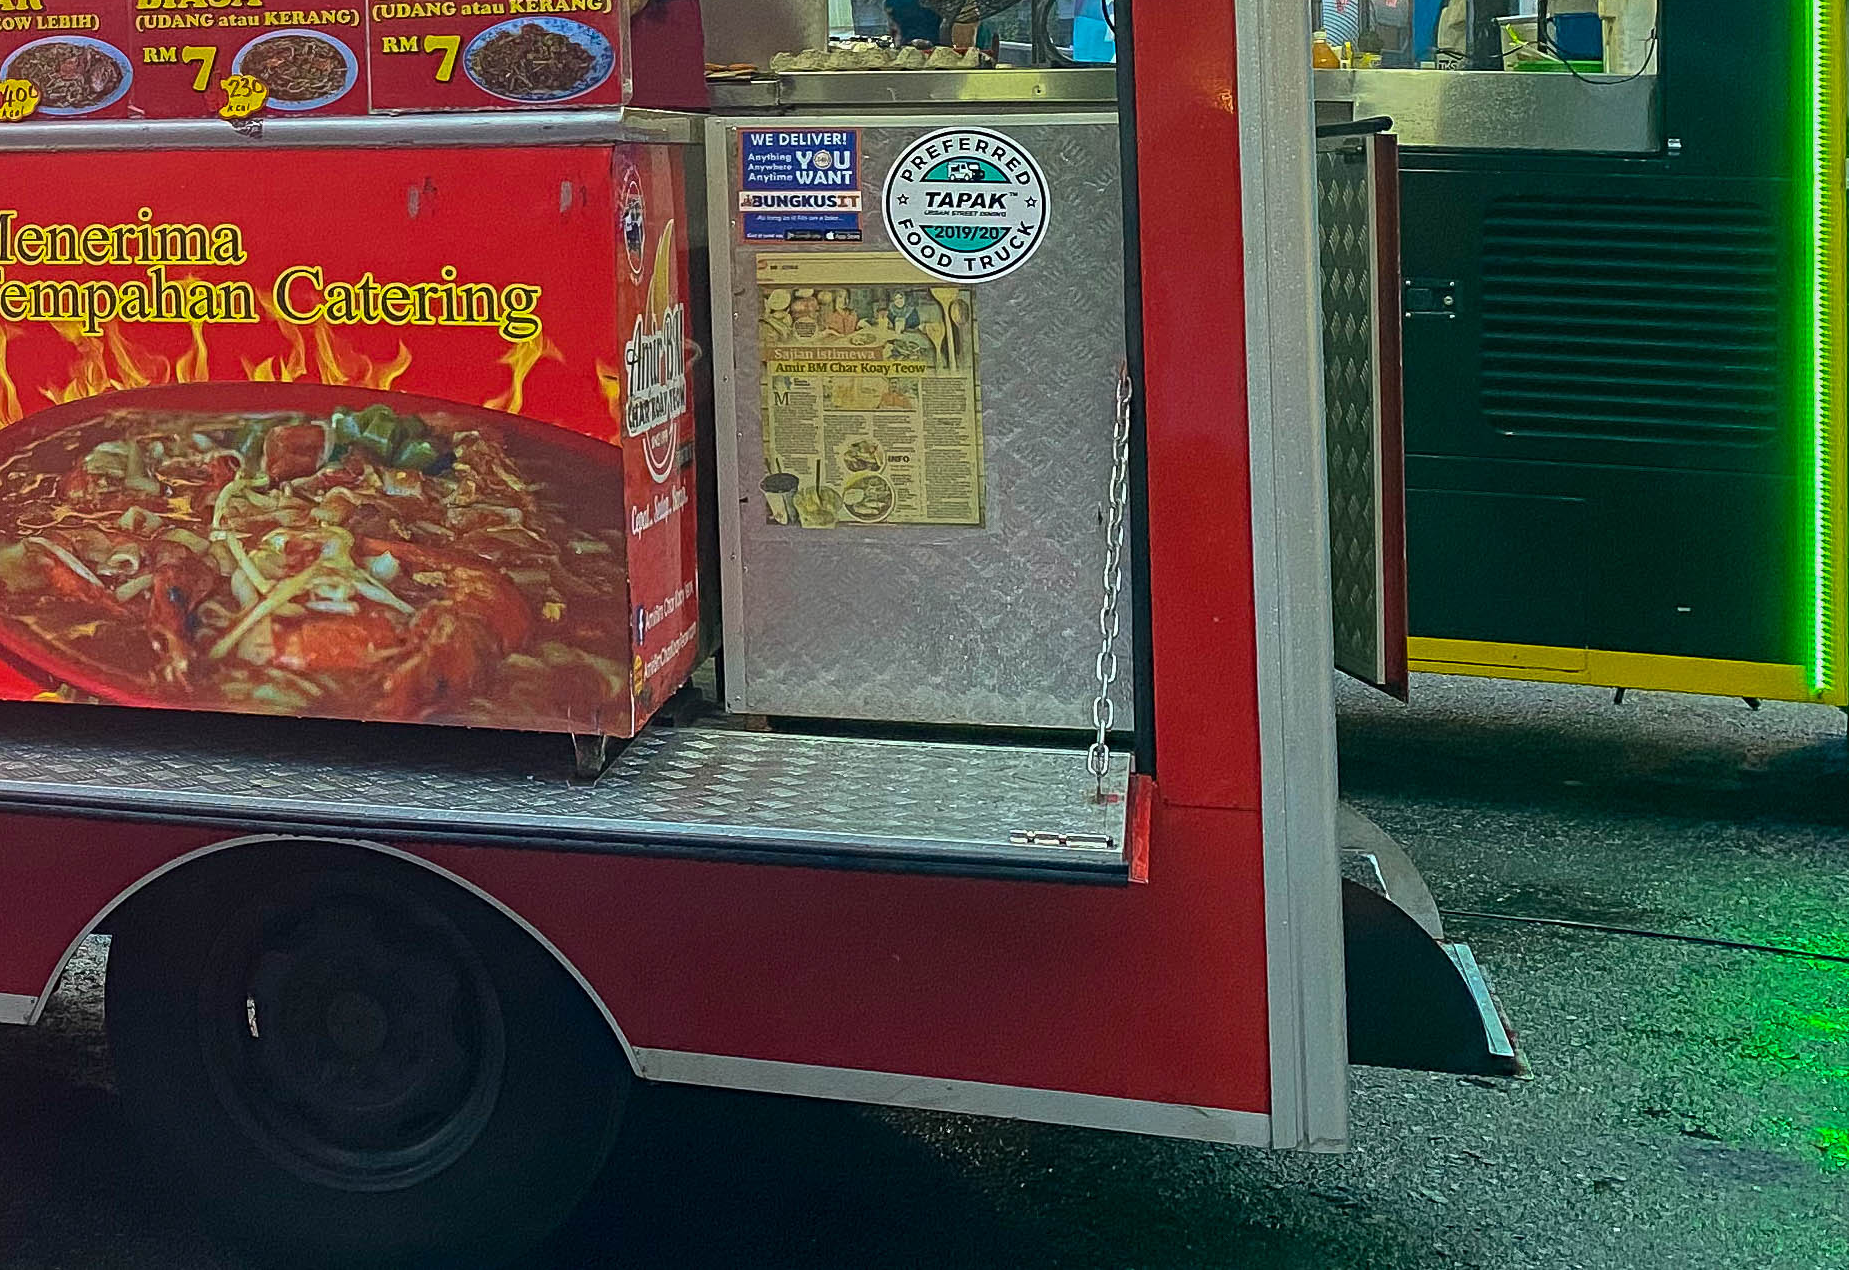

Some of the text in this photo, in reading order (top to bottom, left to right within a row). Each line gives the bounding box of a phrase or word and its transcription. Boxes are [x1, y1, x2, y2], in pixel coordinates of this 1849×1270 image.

[135, 9, 360, 32] (UDANG atau KERANG)
[372, 2, 457, 22] (UDANG
[461, 2, 505, 15] atau
[36, 14, 100, 31] LEBIH)
[381, 34, 461, 82] RM 7
[142, 45, 217, 92] RM 7
[751, 132, 847, 146] WE DELIVER!
[747, 152, 792, 163] Anything
[900, 137, 1031, 186] PREFERRED
[747, 163, 792, 172] Anywhere
[747, 172, 793, 183] Anytime
[795, 170, 853, 185] WANT
[925, 191, 1008, 209] TAPAK
[934, 226, 999, 241] 2019/20
[898, 218, 1035, 272] FOOD TRUCK
[273, 265, 542, 342] Catering
[774, 348, 813, 361] Sajian
[775, 362, 926, 376] Amir BM Char Koay Teow
